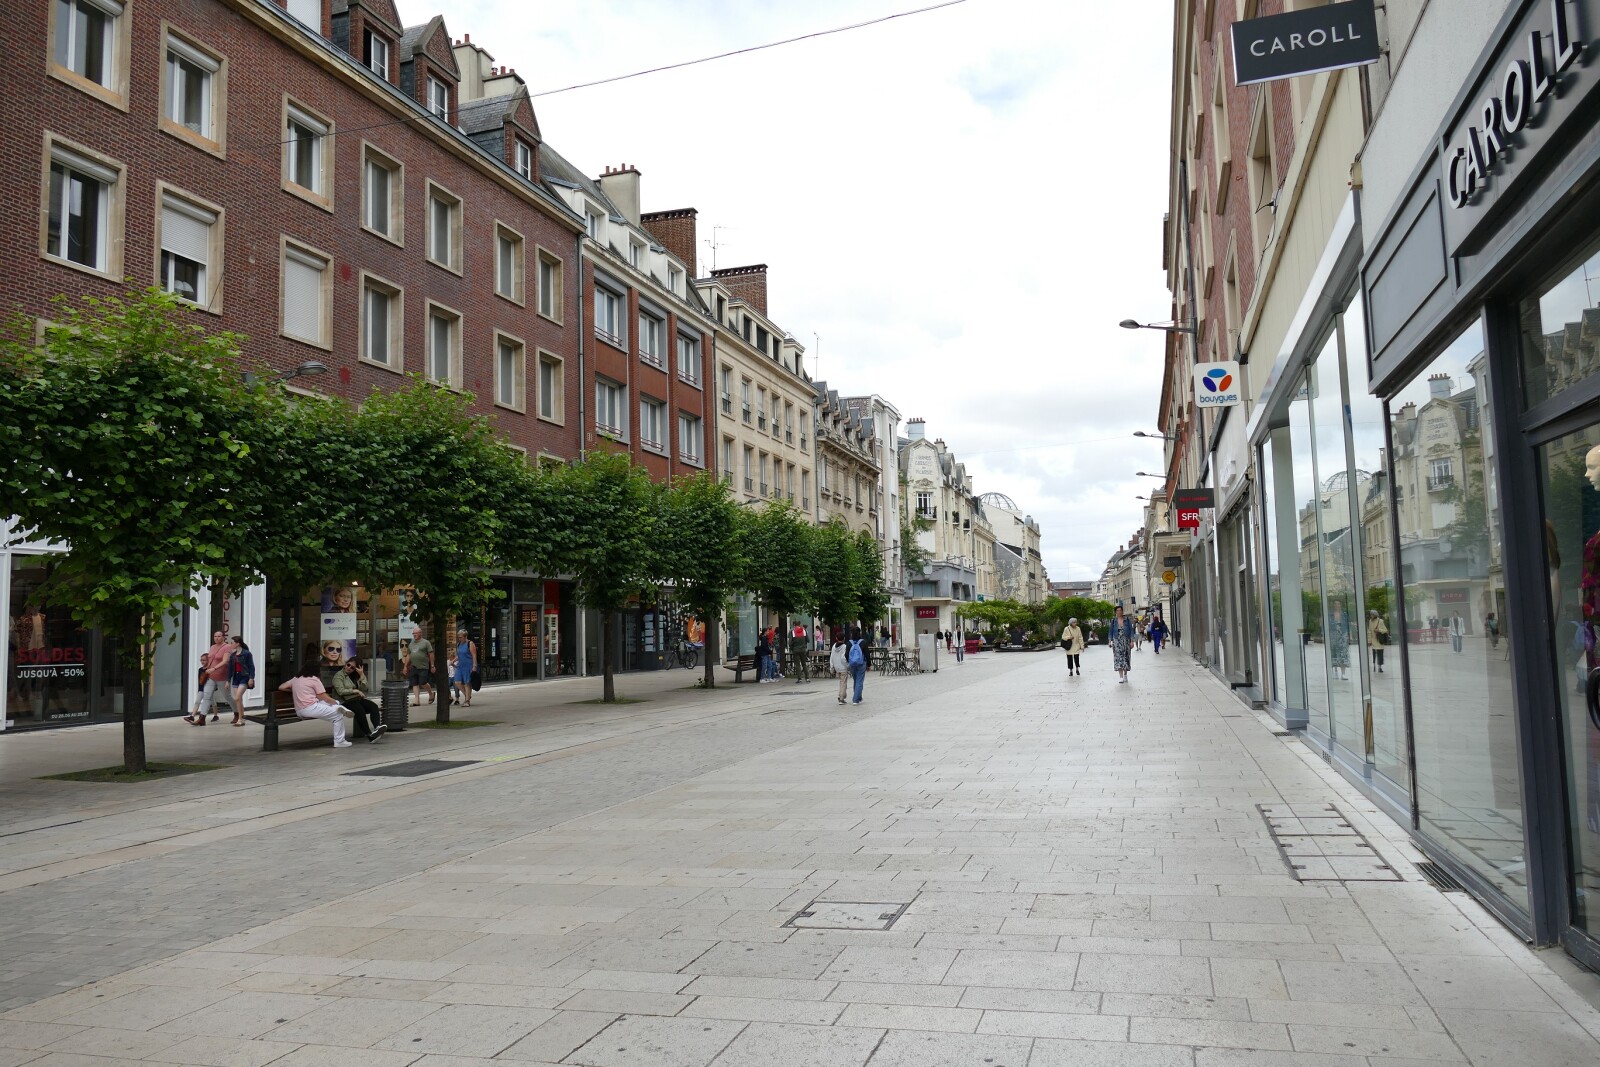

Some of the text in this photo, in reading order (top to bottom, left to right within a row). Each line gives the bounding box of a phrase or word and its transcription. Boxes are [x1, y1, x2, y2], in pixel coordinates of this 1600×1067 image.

[1249, 23, 1361, 57] CAROLL
[1447, 0, 1584, 210] CAROLL
[1199, 394, 1238, 404] bouygues
[1181, 512, 1199, 521] SFR
[222, 590, 230, 643] SOLDE
[16, 647, 85, 663] SOLDES
[17, 667, 85, 679] JUSQU'À -50%
